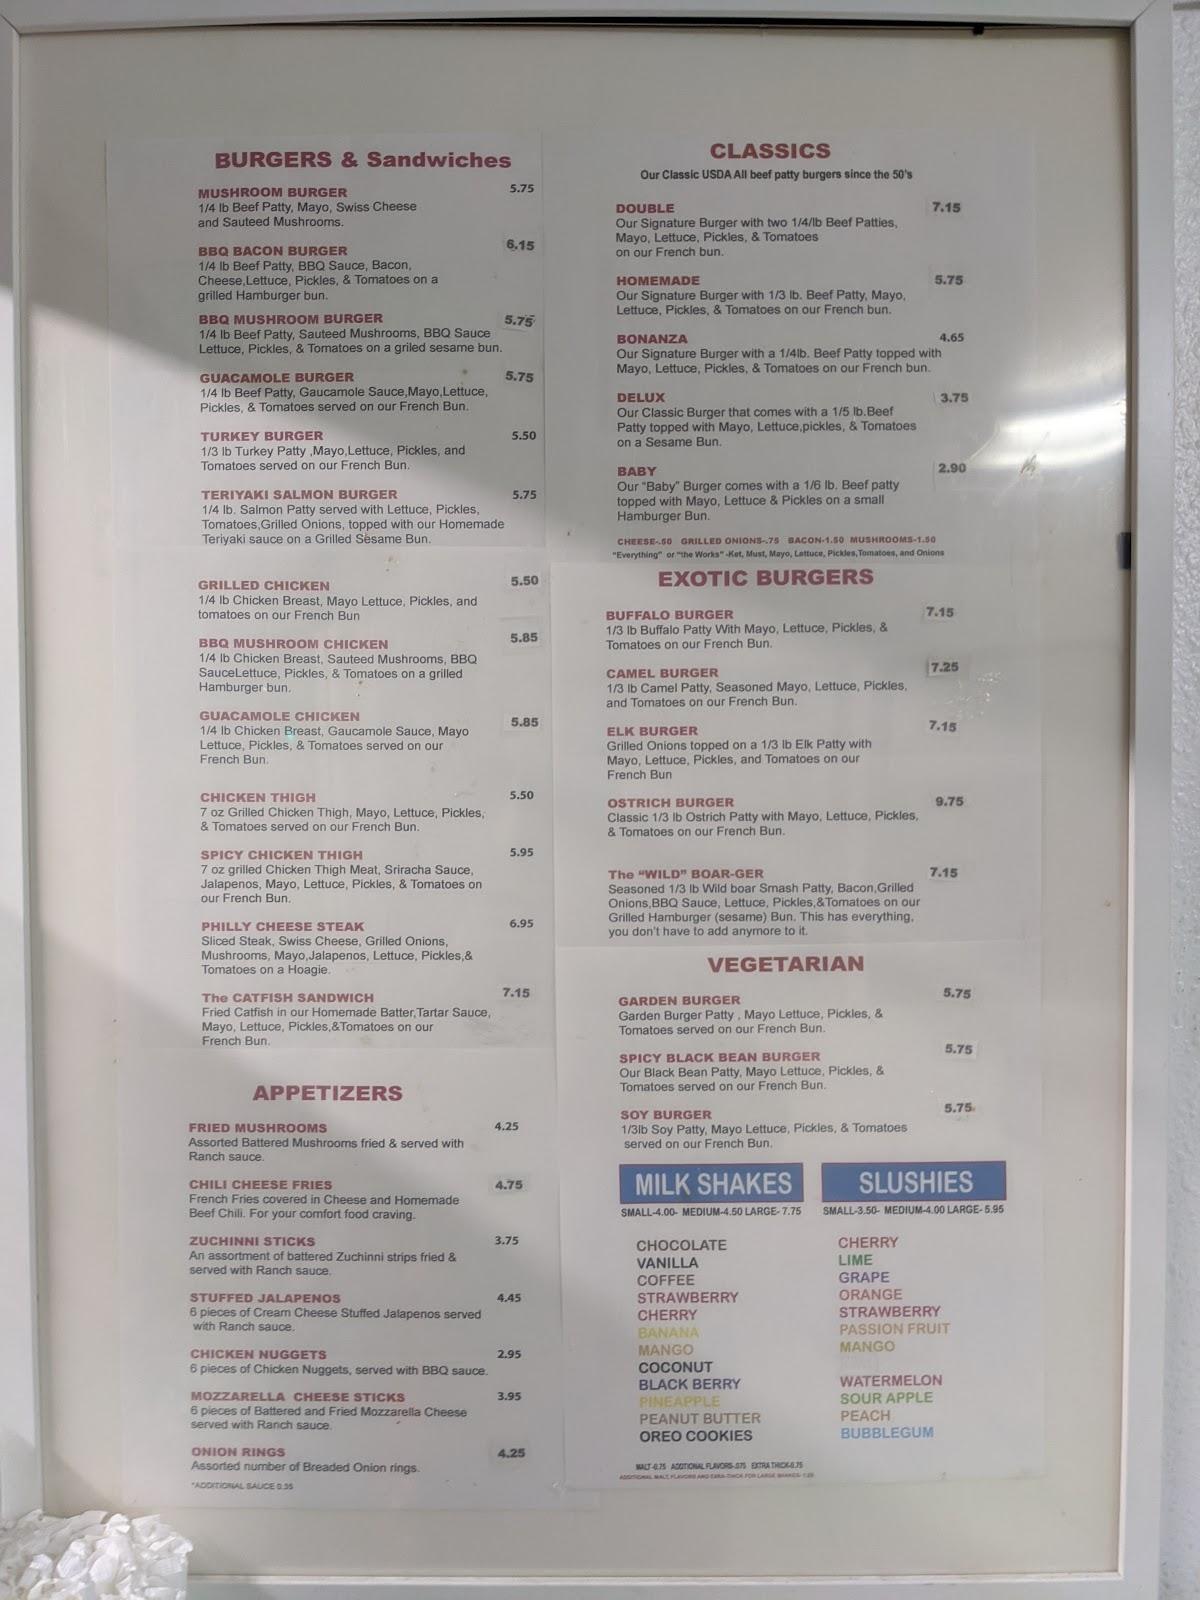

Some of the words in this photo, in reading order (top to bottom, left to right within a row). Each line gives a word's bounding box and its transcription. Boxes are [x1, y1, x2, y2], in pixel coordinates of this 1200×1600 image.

[710, 143, 830, 159] CLASSICS
[216, 152, 332, 168] BURGERS
[341, 152, 359, 168] &
[368, 152, 511, 168] Sandwiches
[640, 170, 660, 180] Our
[662, 170, 699, 180] Classic
[702, 169, 732, 179] USDA
[734, 170, 747, 179] All
[750, 170, 772, 179] beef
[774, 170, 800, 181] patty
[802, 170, 842, 181] burgers
[844, 169, 871, 179] since
[873, 170, 890, 179] the
[893, 169, 912, 179] 50's
[198, 187, 282, 198] MUSHROOM
[288, 188, 347, 197] BURGER
[510, 184, 534, 193] 5.75
[200, 204, 216, 213] 1/4
[219, 202, 229, 212] lb
[232, 202, 260, 212] Beef
[262, 202, 293, 214] Patty,
[298, 202, 332, 214] Mayo,
[336, 202, 370, 212] Swiss
[373, 202, 416, 211] Cheese
[616, 204, 674, 214] DOUBLE
[932, 202, 960, 213] 7.15
[198, 217, 218, 227] and
[223, 216, 270, 227] Sauteed
[274, 216, 344, 227] Mushrooms.
[617, 276, 700, 286] HOMEMADE
[935, 275, 963, 285] 5.75
[199, 315, 229, 325] BBQ
[234, 315, 319, 324] MUSHROOM
[324, 314, 383, 324] BURGER
[617, 334, 688, 344] BONANZA
[940, 333, 964, 342] 4.65
[200, 373, 290, 383] GUACAMOLE
[295, 372, 354, 382] BURGER
[506, 371, 534, 382] 5.75
[618, 393, 665, 403] DELUX
[941, 393, 968, 403] 3.75
[201, 432, 260, 442] TURKEY
[264, 431, 323, 441] BURGER
[512, 431, 536, 440] 5.50
[201, 461, 256, 471] Tomatoes
[260, 460, 297, 470] served
[301, 462, 315, 470] on
[319, 462, 338, 470] our
[341, 460, 380, 470] French
[385, 460, 409, 470] Bun.
[938, 463, 966, 473] 2.90
[618, 466, 656, 476] BABY
[201, 490, 268, 500] TERIYAKI
[273, 490, 333, 500] SALMON
[339, 490, 398, 500] BURGER
[512, 490, 536, 499] 5.75
[511, 576, 538, 586] 5.50
[659, 570, 748, 587] EXOTIC
[757, 569, 874, 586] BURGERS
[198, 580, 260, 590] GRILLED
[264, 581, 329, 591] CHICKEN
[606, 610, 670, 621] BUFFALO
[675, 610, 733, 620] BURGER
[926, 606, 954, 618] 7.15
[607, 727, 634, 736] ELK
[640, 726, 698, 736] BURGER
[930, 720, 956, 732] 7.15
[200, 793, 266, 802] CHICKEN
[270, 793, 316, 802] THIGH
[510, 791, 534, 800] 5.50
[608, 798, 670, 808] OSTRICH
[676, 798, 734, 808] BURGER
[936, 796, 964, 806] 9.75
[608, 870, 634, 879] The
[691, 869, 764, 879] BOAR-GER
[930, 867, 958, 878] 7.15
[202, 922, 251, 931] PHILLY
[256, 922, 312, 931] CHEESE
[317, 922, 364, 932] STEAK
[510, 919, 533, 928] 6.95
[609, 928, 628, 939] you
[632, 926, 660, 936] don't
[663, 926, 690, 936] have
[694, 926, 704, 936] to
[707, 926, 728, 936] add
[732, 928, 781, 938] anymore
[785, 926, 795, 936] to
[799, 925, 808, 936] it.
[708, 956, 864, 972] VEGETARIAN
[202, 993, 228, 1003] The
[232, 993, 293, 1002] CATFISH
[298, 993, 374, 1003] SANDWICH
[503, 988, 530, 998] 7.15
[944, 988, 971, 999] 5.75
[618, 996, 677, 1006] GARDEN
[682, 996, 740, 1005] BURGER
[946, 1044, 972, 1054] 5.75
[253, 1085, 402, 1101] APPETIZERS
[621, 1110, 649, 1120] SOY
[654, 1110, 712, 1120] BURGER
[189, 1123, 230, 1132] FRIED
[235, 1124, 327, 1133] MUSHROOMS
[495, 1122, 518, 1131] 4.25
[189, 1180, 227, 1190] CHILI
[232, 1180, 288, 1190] CHEESE
[292, 1180, 332, 1190] FRIES
[495, 1180, 523, 1190] 4.75
[636, 1173, 690, 1195] MILK
[698, 1172, 792, 1195] SHAKES
[860, 1171, 973, 1194] SLUSHIES
[190, 1208, 216, 1218] Beef
[218, 1208, 245, 1218] Chili.
[250, 1208, 269, 1218] For
[272, 1210, 298, 1220] your
[299, 1208, 342, 1219] comfort
[344, 1209, 369, 1219] food
[372, 1208, 416, 1222] craving.
[621, 1208, 678, 1217] SMALL-4.00-
[682, 1207, 743, 1216] MEDIUM-4.50
[745, 1207, 780, 1216] LARGE-
[782, 1207, 801, 1215] 7.75
[190, 1236, 259, 1246] ZUCHINNI
[264, 1237, 316, 1246] STICKS
[496, 1236, 518, 1245] 3.75
[838, 1236, 898, 1248] CHERRY
[637, 1240, 727, 1252] CHOCOLATE
[637, 1257, 698, 1269] VANILLA
[839, 1254, 872, 1266] LIME
[190, 1293, 253, 1303] STUFFED
[258, 1294, 341, 1303] JALAPENOS
[497, 1294, 521, 1302] 4.45
[190, 1349, 254, 1359] CHICKEN
[259, 1350, 326, 1360] NUGGETS
[498, 1350, 521, 1358] 2.95
[639, 1362, 713, 1374] COCONUT
[639, 1379, 688, 1390] BLACK
[692, 1378, 741, 1390] BERRY
[840, 1374, 942, 1387] WATERMELON
[840, 1392, 882, 1404] SOUR
[886, 1392, 933, 1404] APPLE
[640, 1430, 682, 1442] OREO
[686, 1430, 752, 1442] COOKIES
[841, 1427, 934, 1439] BUBBLEGUM
[192, 1447, 237, 1456] ONION
[242, 1448, 286, 1457] RINGS
[498, 1448, 525, 1458] 4.25
[246, 1482, 275, 1490] SAUCE
